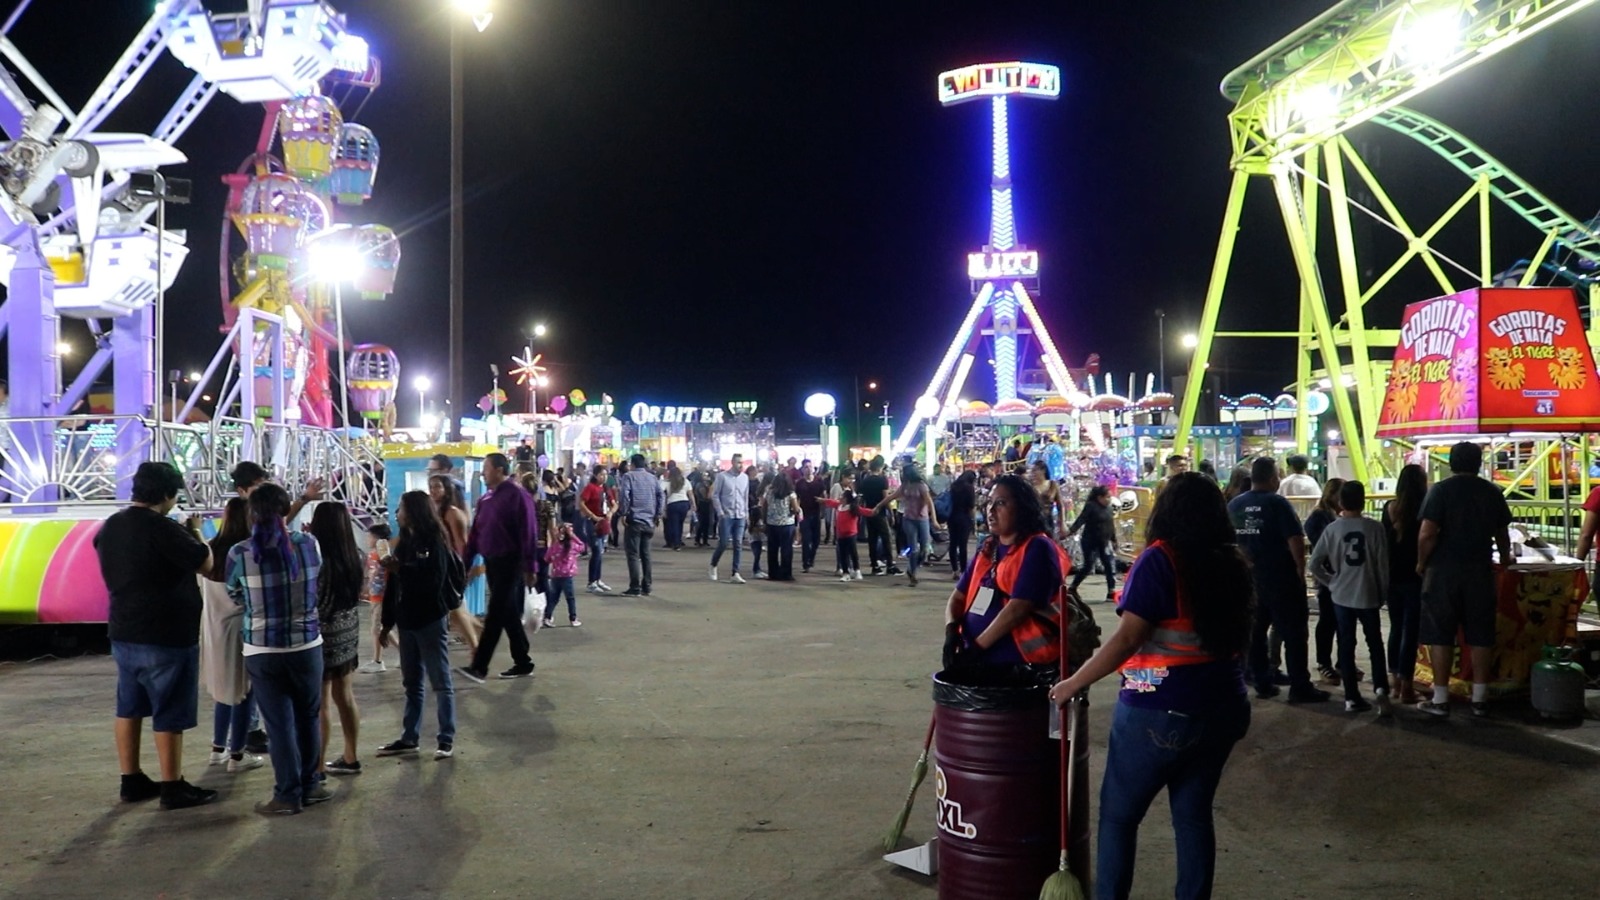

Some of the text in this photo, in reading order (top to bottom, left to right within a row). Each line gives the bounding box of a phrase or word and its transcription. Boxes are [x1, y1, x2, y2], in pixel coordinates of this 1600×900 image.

[943, 66, 1056, 98] EVOLUTION
[1401, 299, 1475, 350] GORDITAS
[1488, 310, 1567, 338] GORDITAS
[1508, 328, 1553, 346] DE NATA
[1414, 330, 1456, 362] DE NATA
[1512, 345, 1555, 359] EL TIGRE
[1410, 358, 1453, 384] EL TIGRE
[1344, 531, 1366, 566] 3
